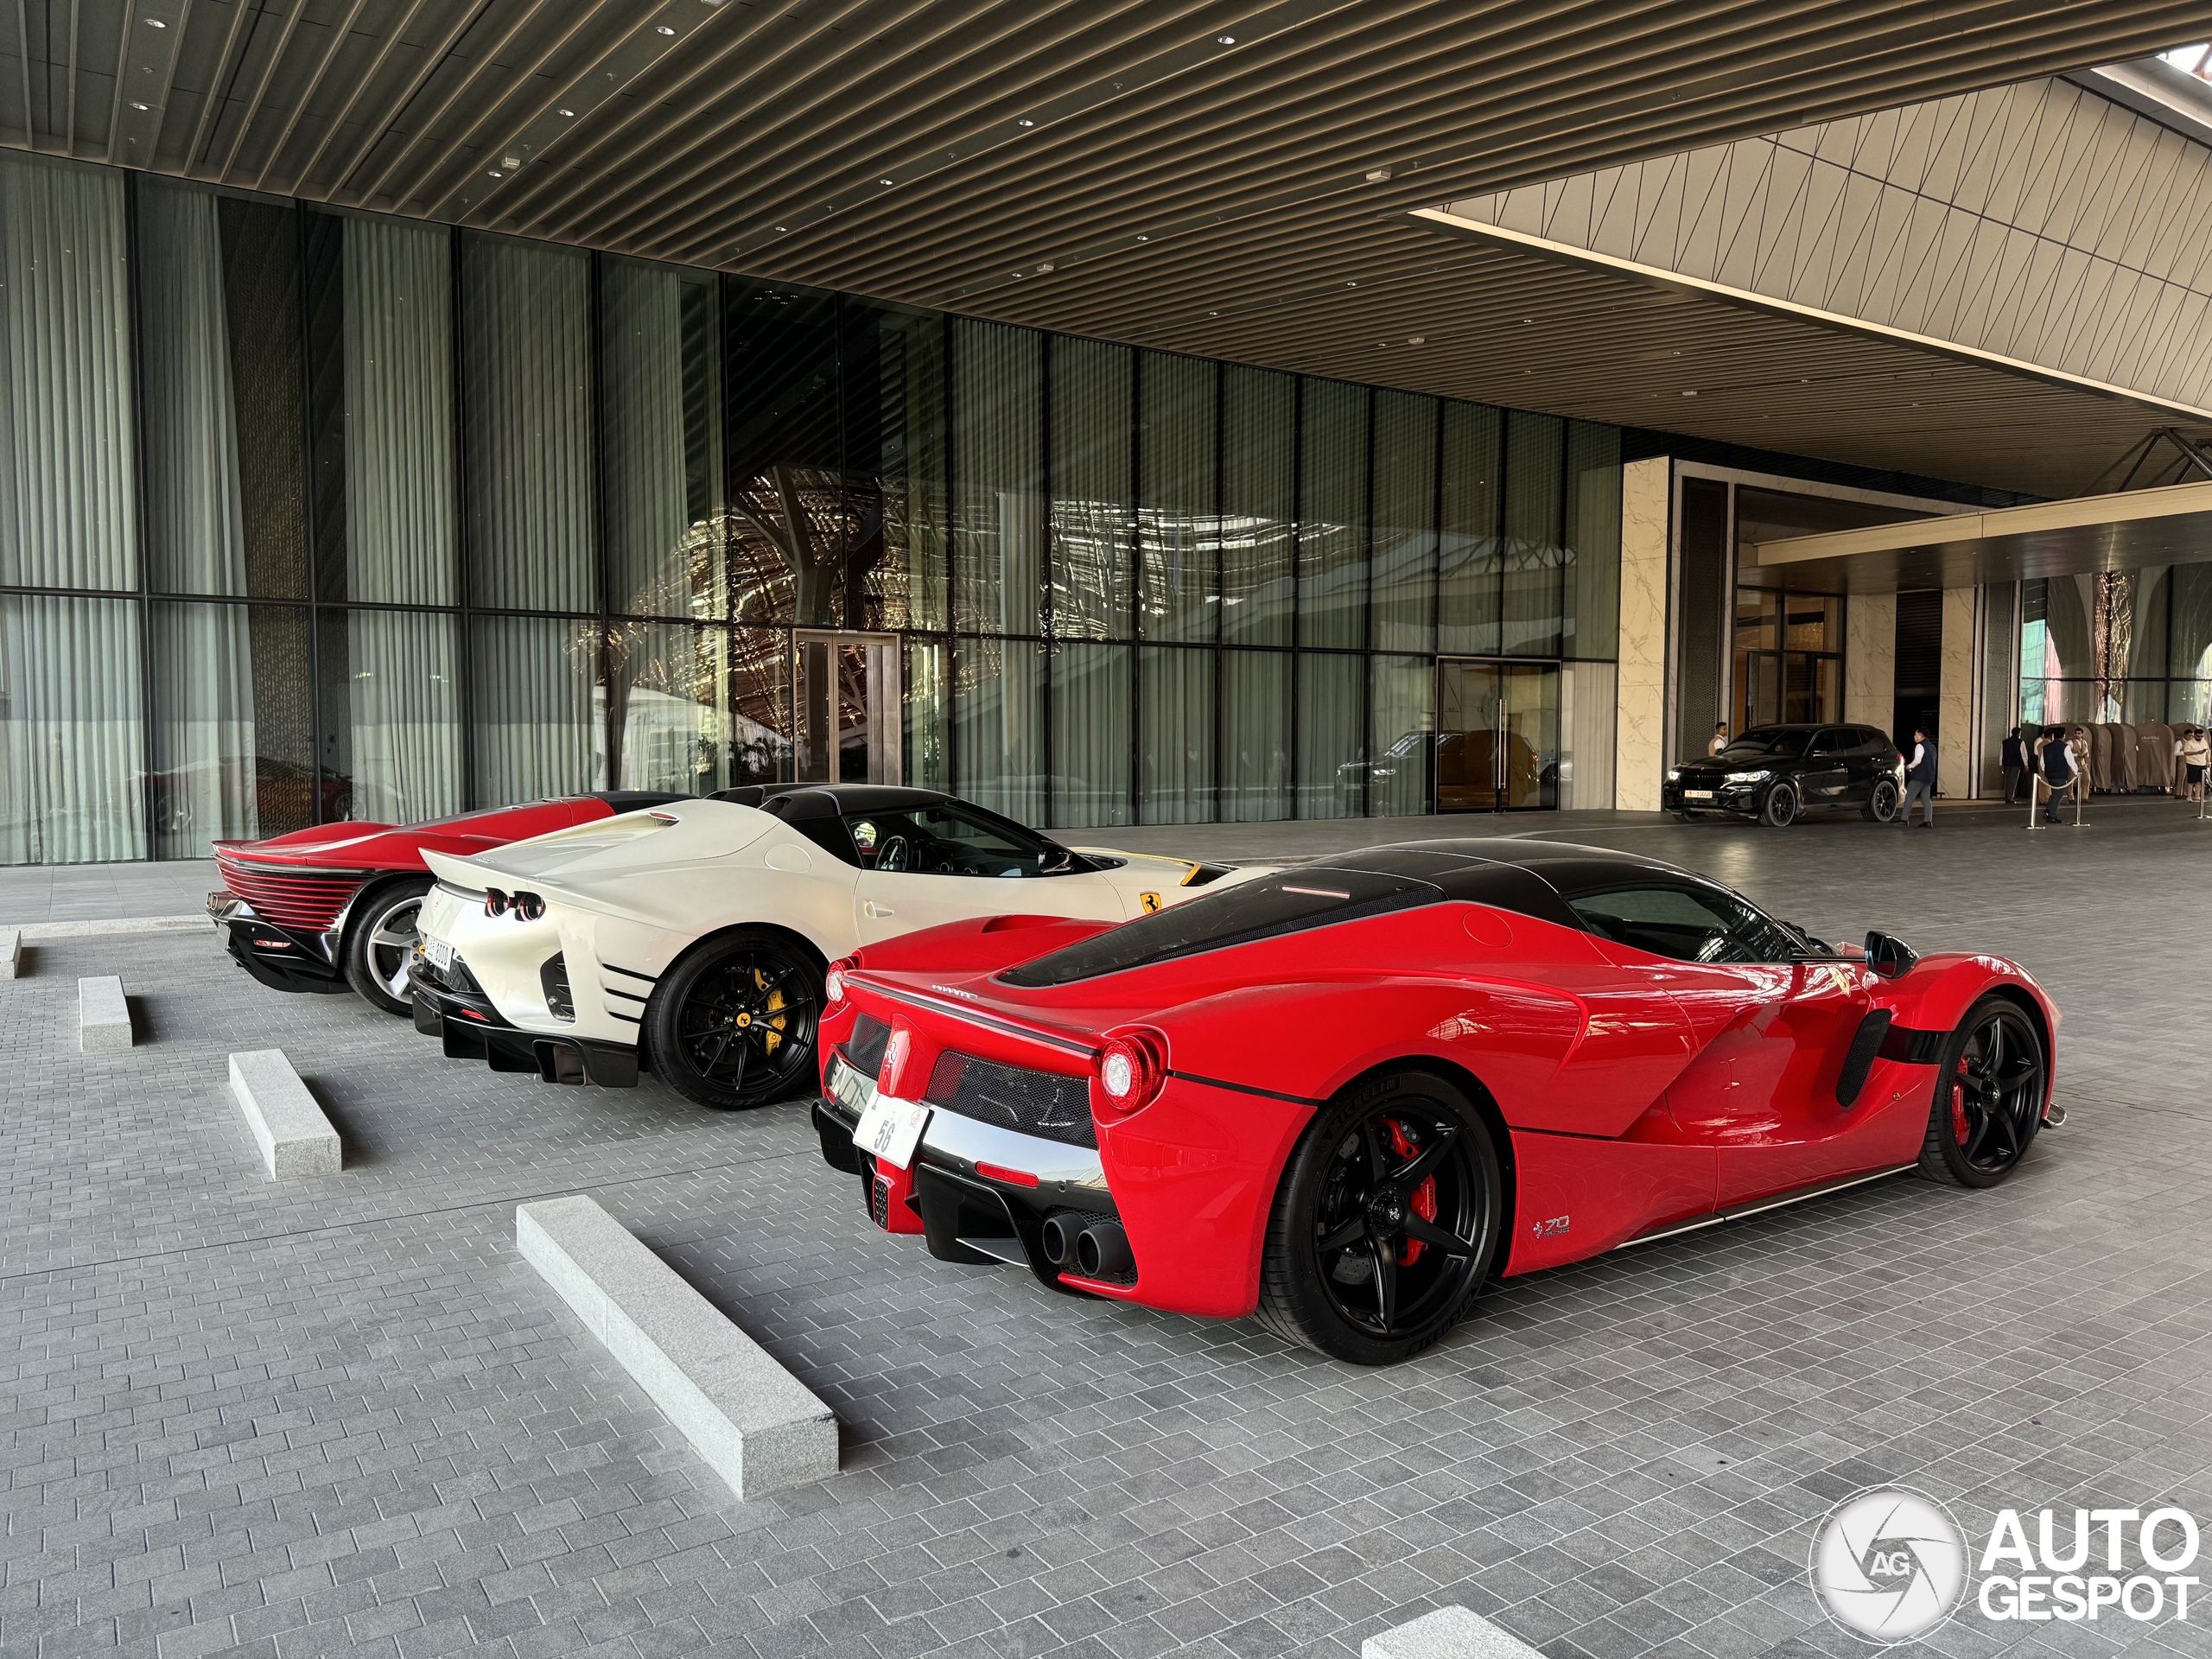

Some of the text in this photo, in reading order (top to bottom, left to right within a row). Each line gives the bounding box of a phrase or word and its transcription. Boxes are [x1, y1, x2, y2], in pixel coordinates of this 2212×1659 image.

[1329, 1077, 1397, 1135] MICHELIN
[874, 1120, 895, 1153] 56
[1545, 1215, 1570, 1232] 70
